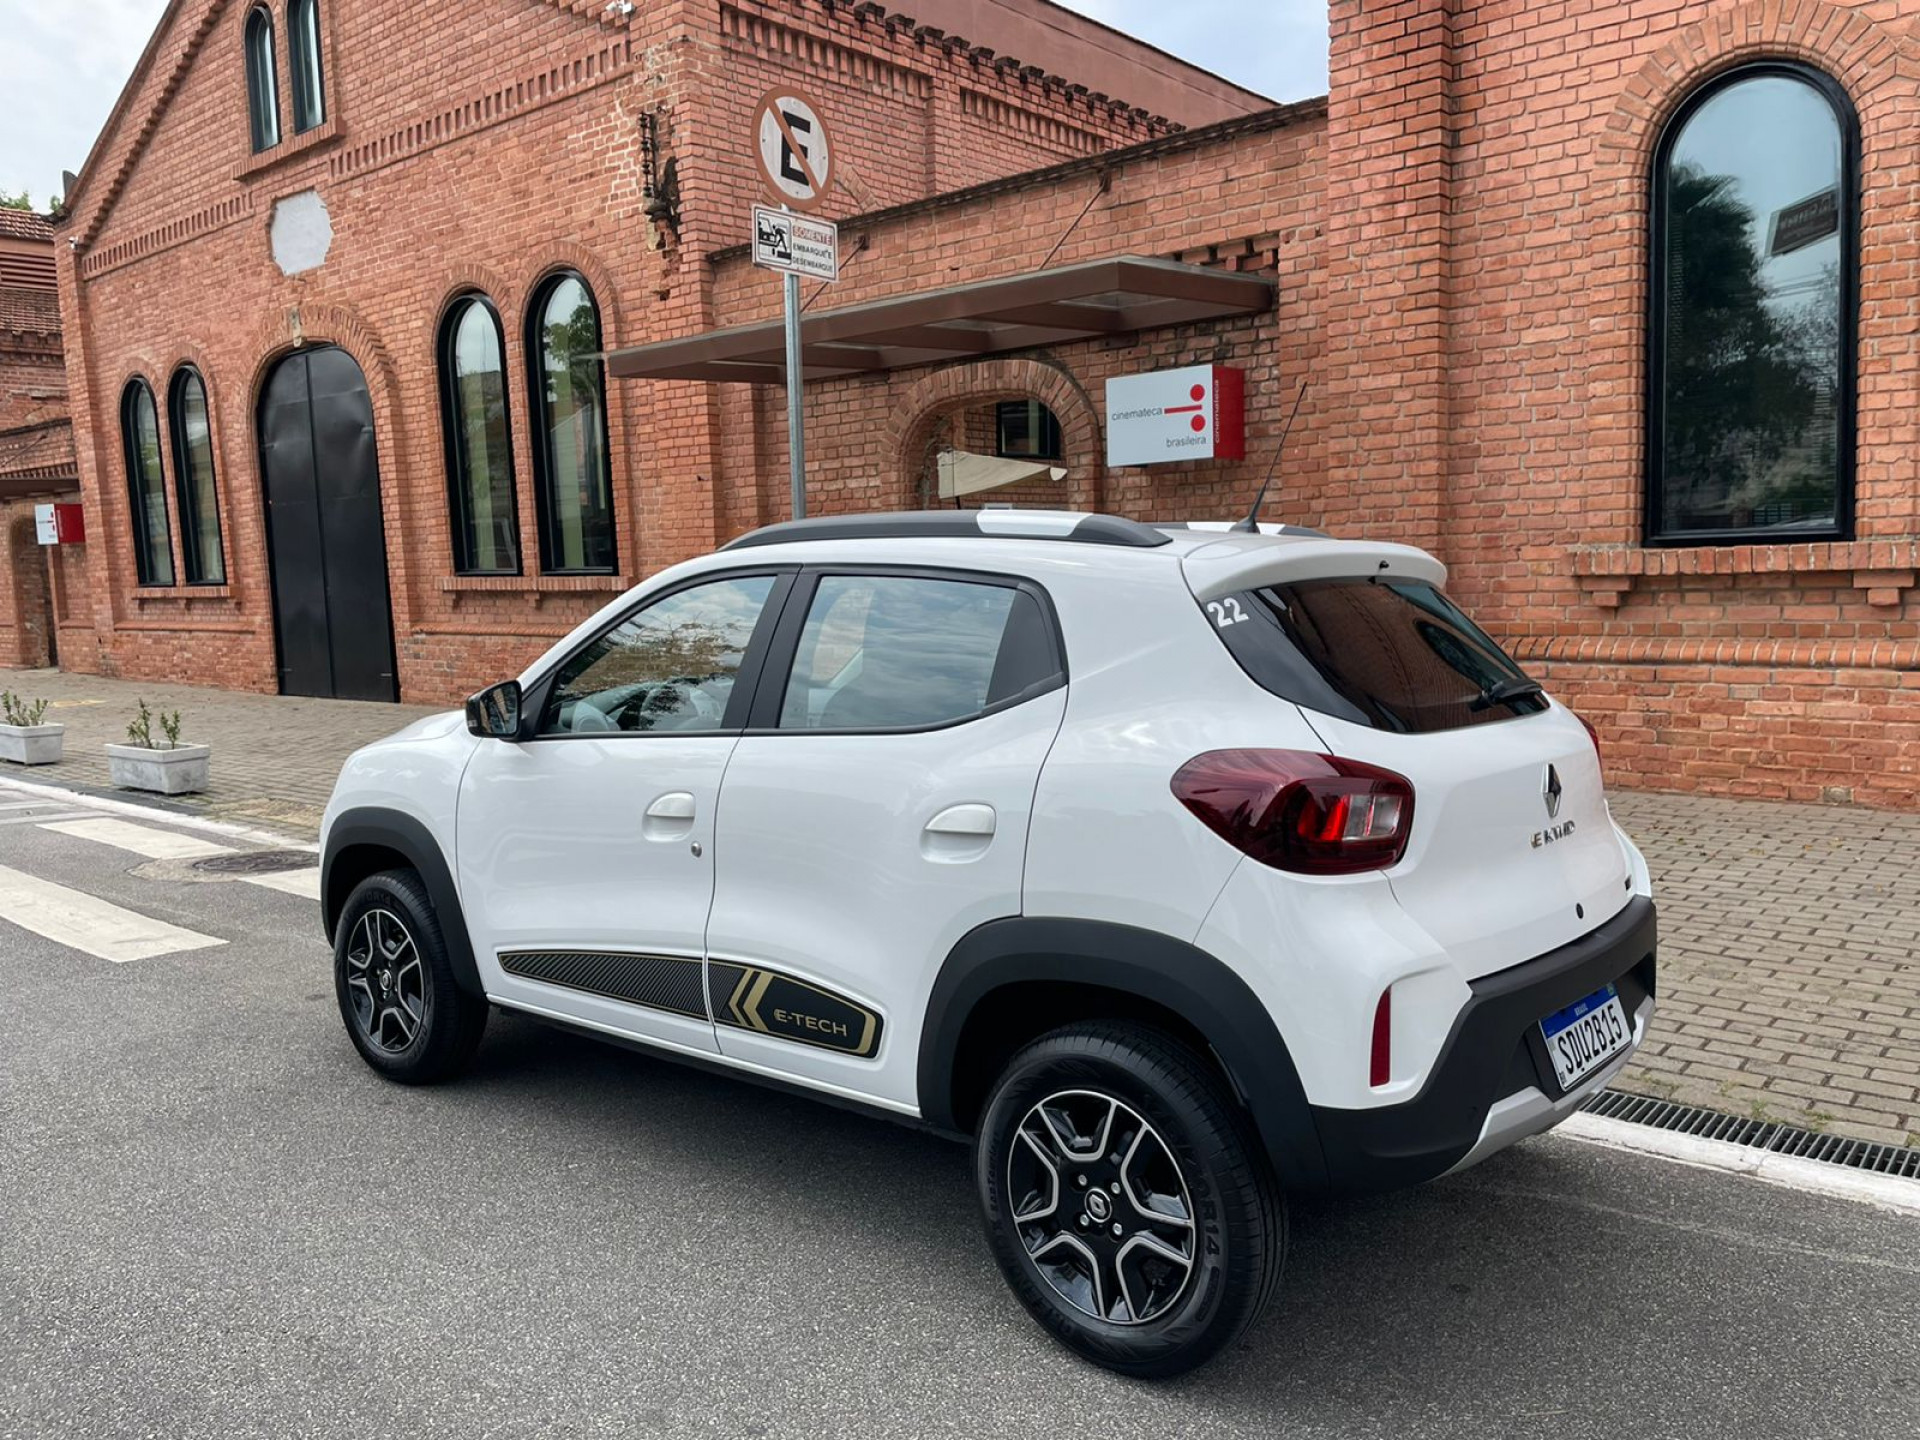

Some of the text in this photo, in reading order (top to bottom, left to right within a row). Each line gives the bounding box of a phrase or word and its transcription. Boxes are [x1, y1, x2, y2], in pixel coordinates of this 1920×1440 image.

[781, 110, 811, 186] E
[792, 226, 833, 247] SOMENTE
[792, 243, 828, 259] EMBARQUE
[792, 256, 833, 273] DESEMBARQUE
[1111, 406, 1163, 421] cinemateca
[1166, 435, 1207, 448] brasileira
[1206, 597, 1250, 628] 22
[773, 1008, 847, 1037] E-TECH
[1557, 1004, 1622, 1075] SDU2B15
